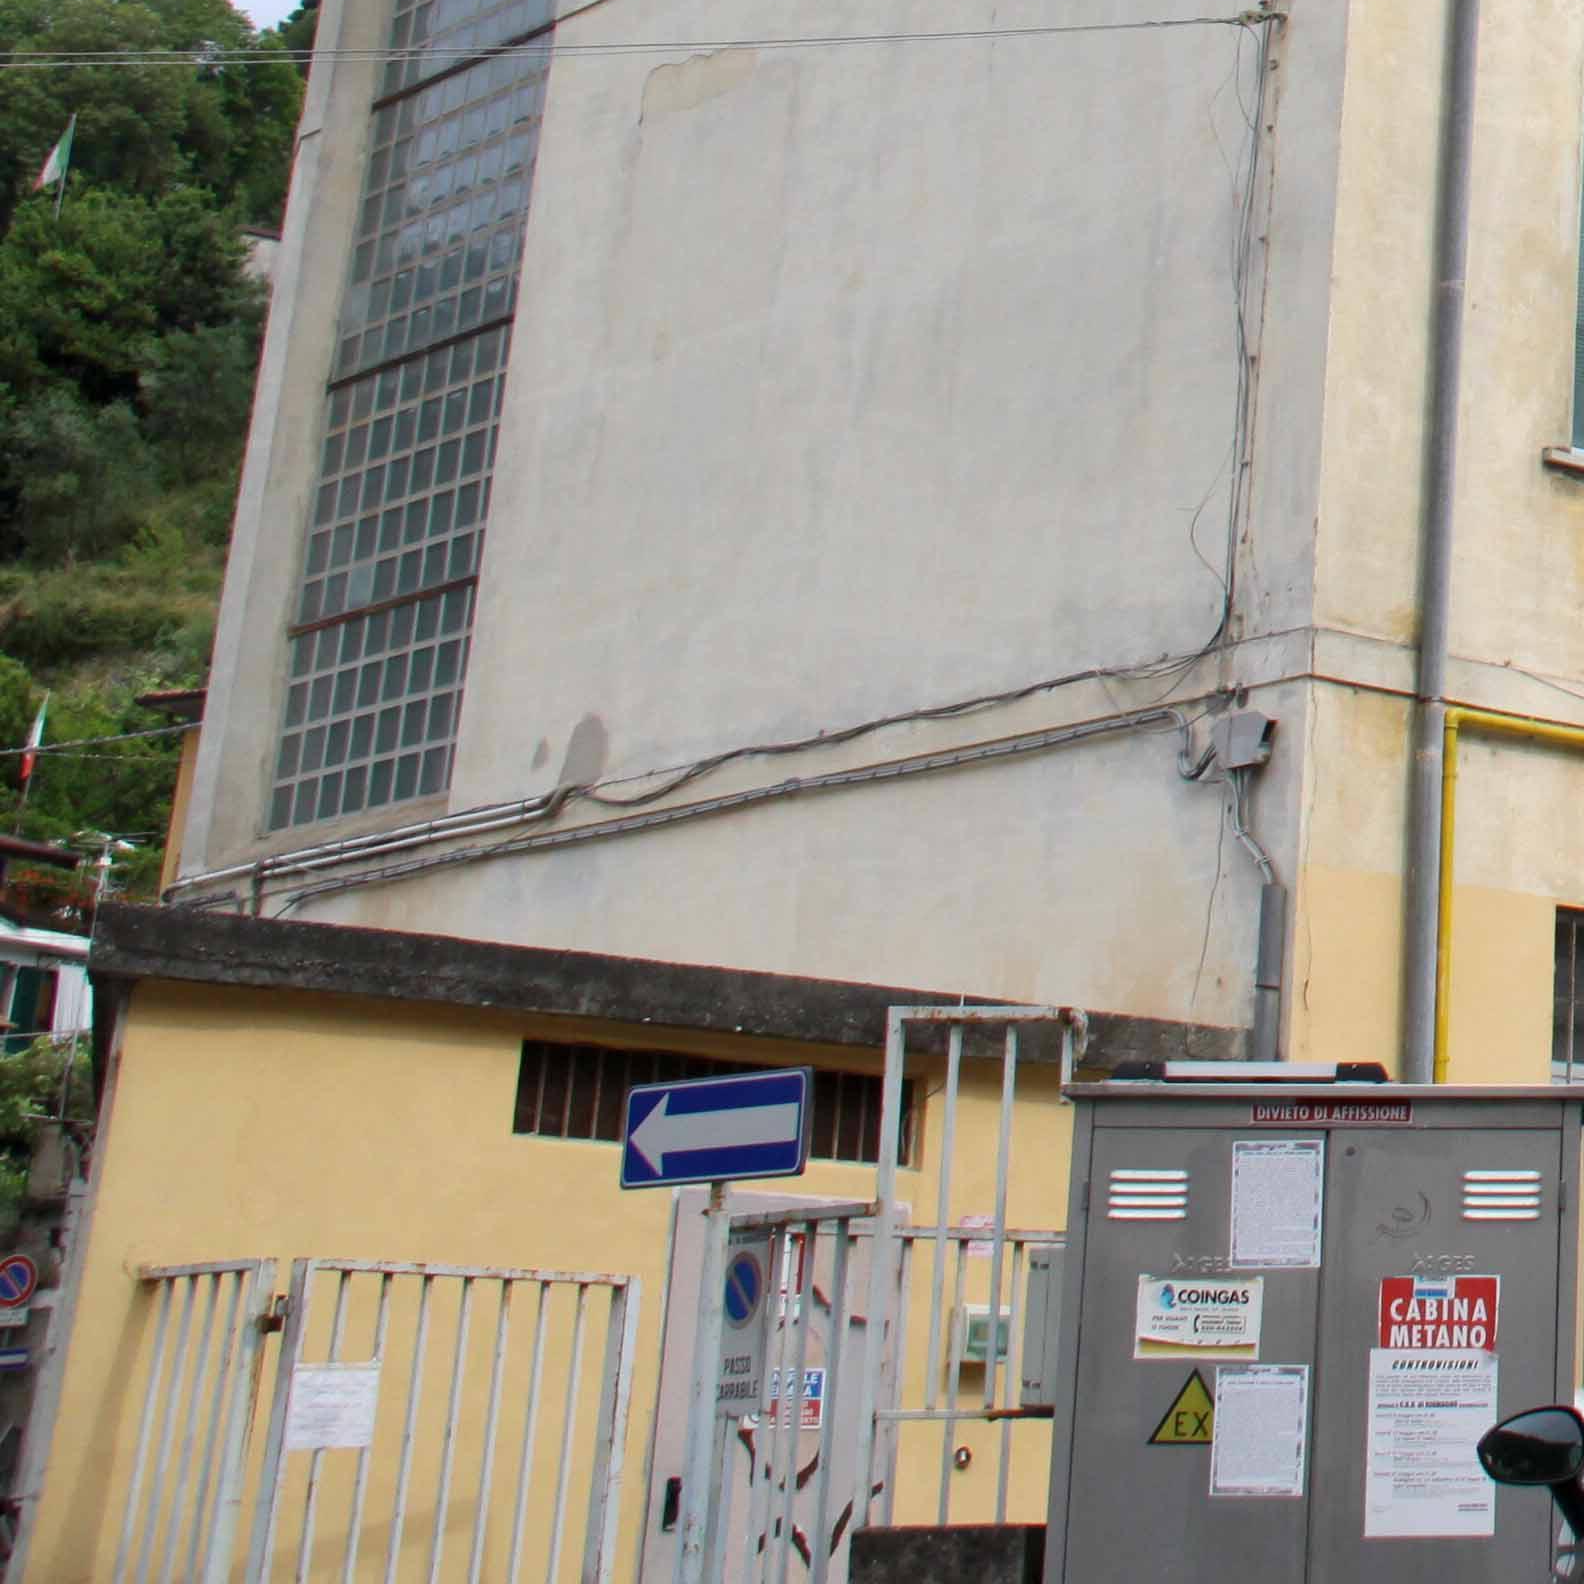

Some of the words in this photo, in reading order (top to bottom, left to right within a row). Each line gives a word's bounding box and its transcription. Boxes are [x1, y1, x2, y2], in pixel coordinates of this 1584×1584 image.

[1256, 1104, 1310, 1120] DIVIETO
[1314, 1104, 1329, 1120] DI
[1332, 1104, 1408, 1120] AFFISSIONE
[1178, 1289, 1250, 1305] COINGAS
[1389, 1297, 1488, 1322] CABINA
[1389, 1324, 1487, 1348] METANO
[723, 1356, 752, 1375] PASSO
[1391, 1359, 1478, 1370] CONTROVISIONI
[1174, 1410, 1209, 1438] EX
